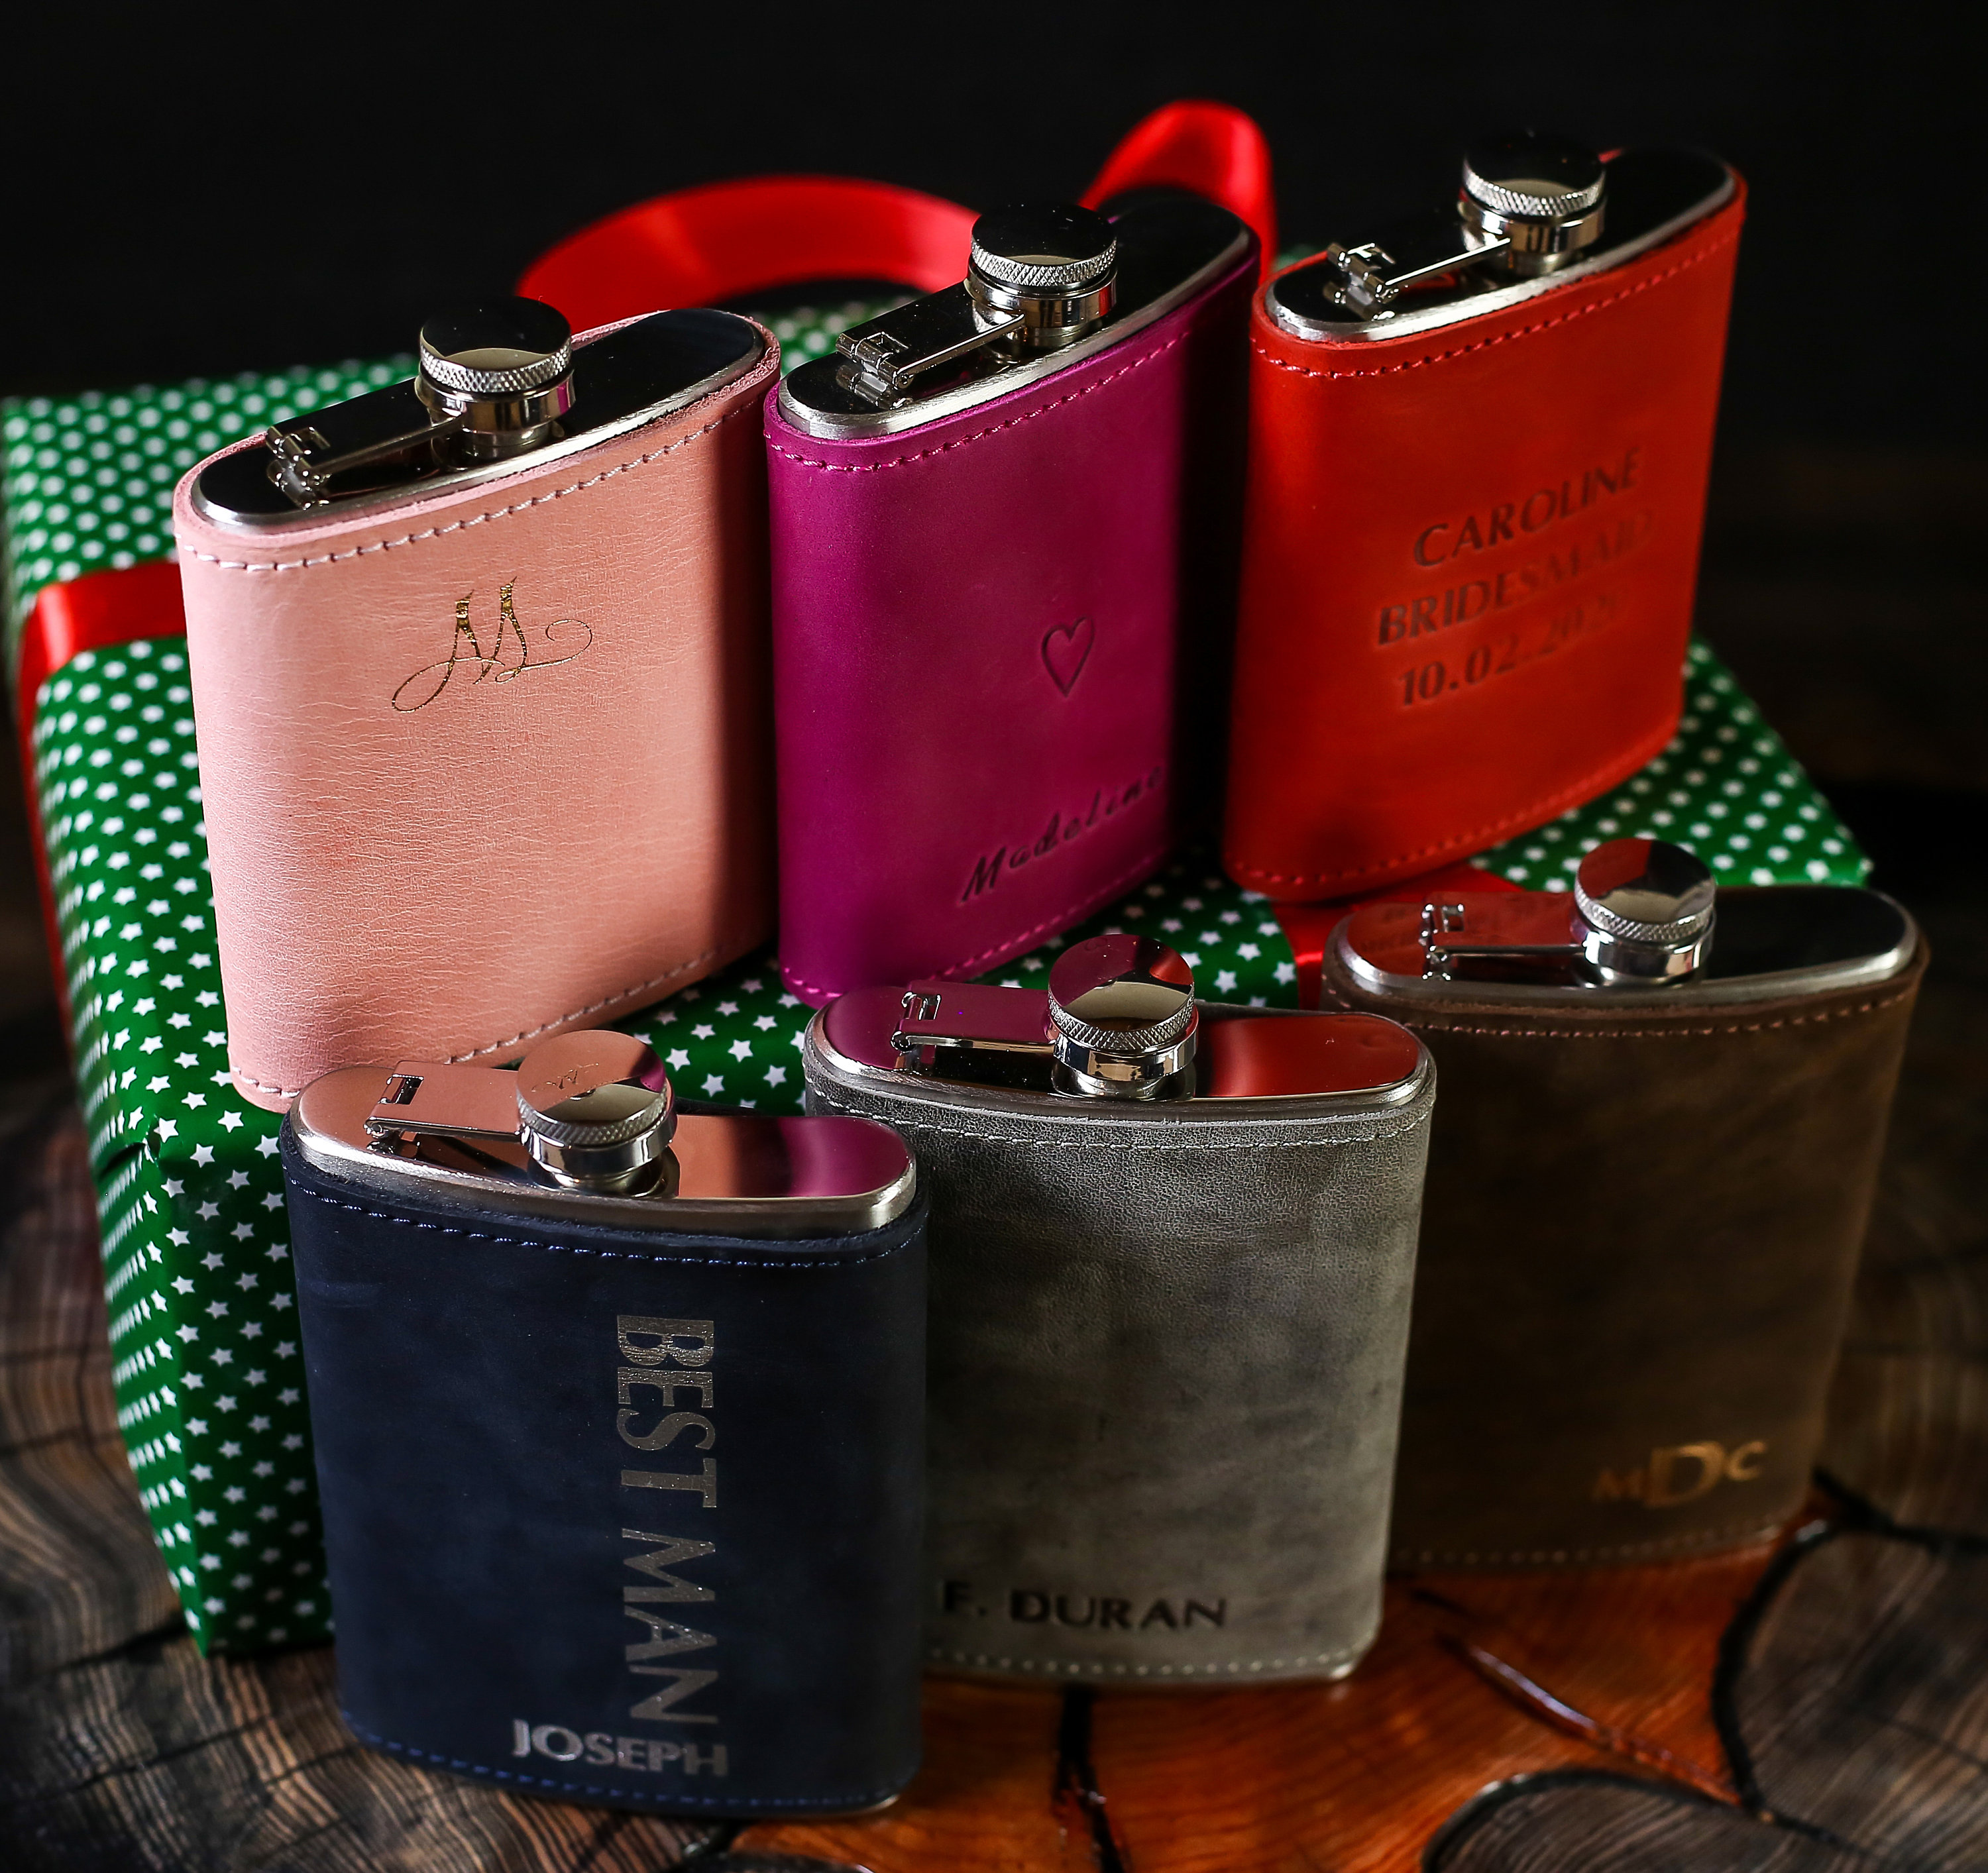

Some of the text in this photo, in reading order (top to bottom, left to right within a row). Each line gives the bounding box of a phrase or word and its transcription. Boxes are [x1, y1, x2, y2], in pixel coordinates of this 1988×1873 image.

[1413, 447, 1640, 567] CAROLINE
[960, 766, 1164, 902] Madeline
[616, 1314, 720, 1724] BEST MAN
[943, 1581, 1228, 1630] F. DURAN
[514, 1719, 728, 1777] JOSEPH
